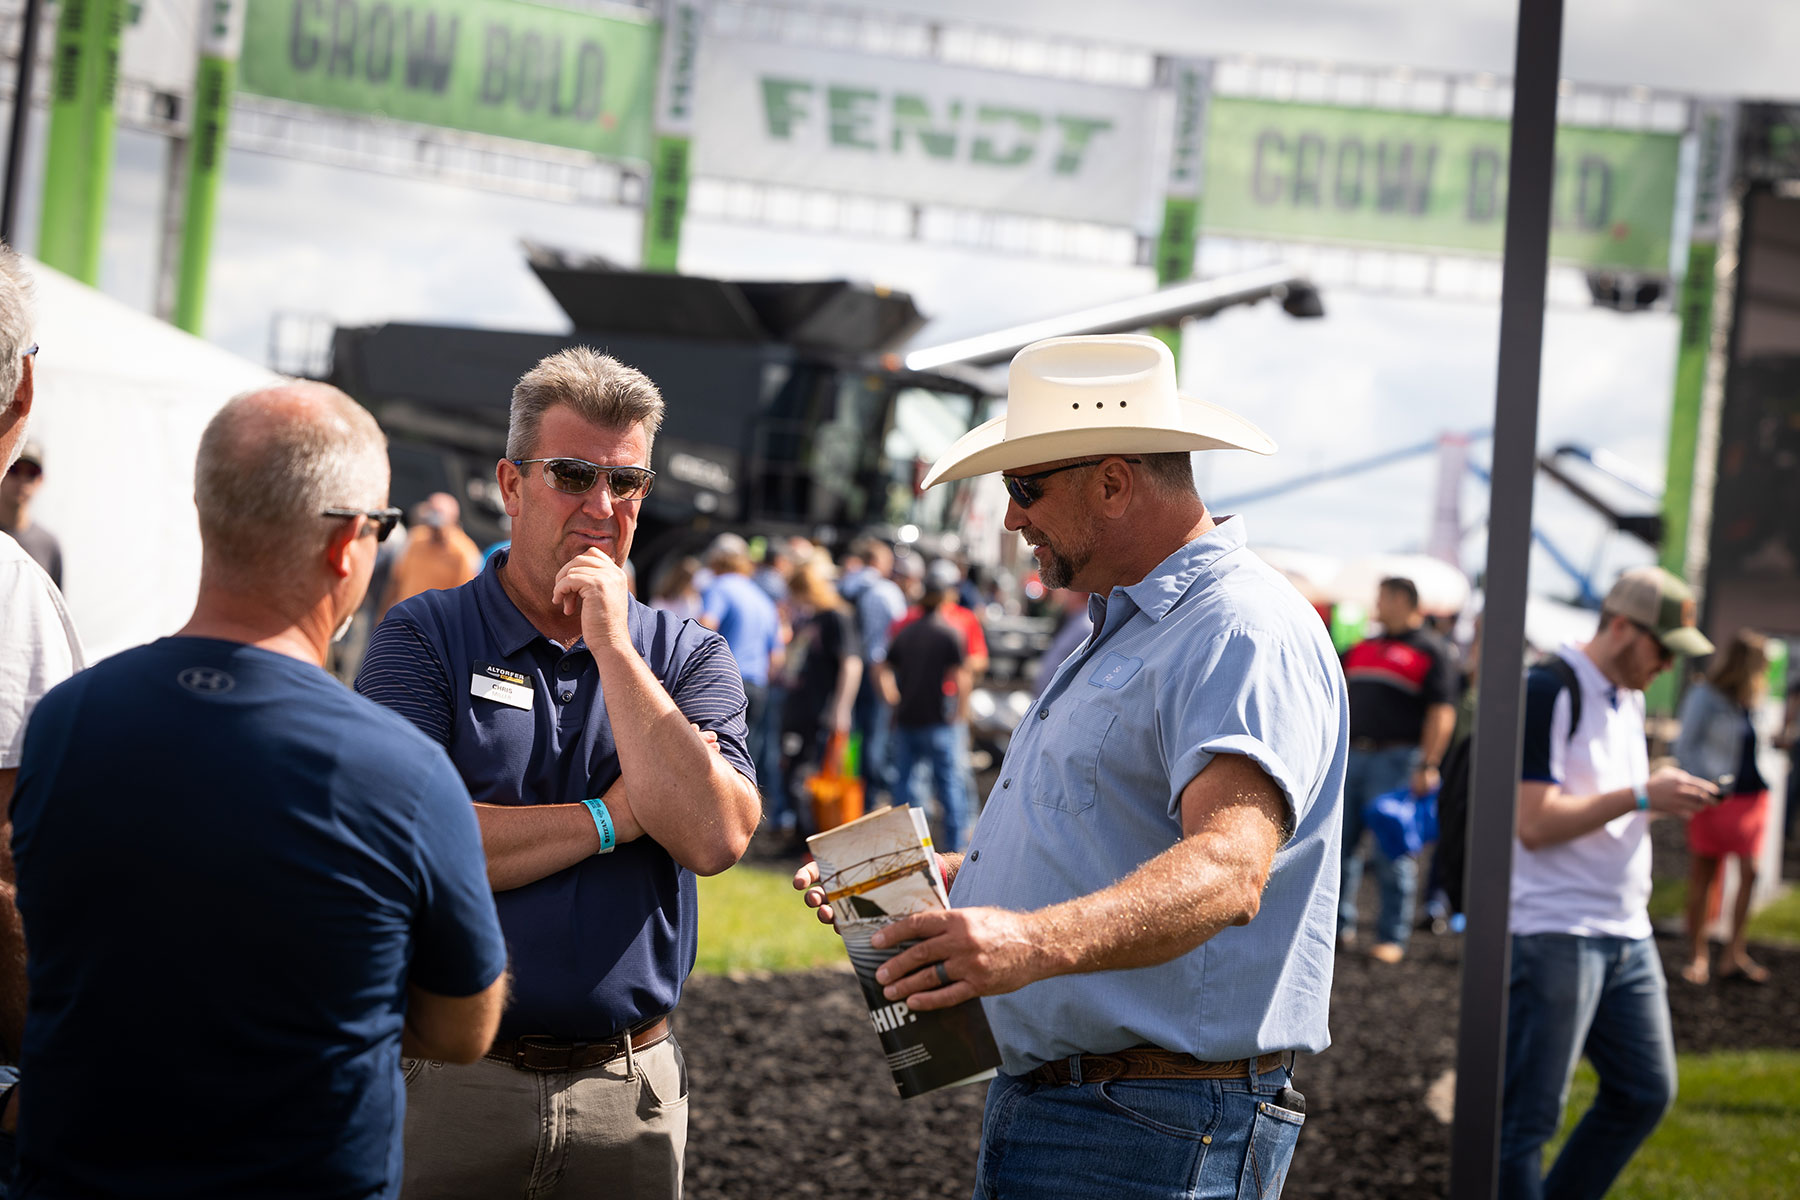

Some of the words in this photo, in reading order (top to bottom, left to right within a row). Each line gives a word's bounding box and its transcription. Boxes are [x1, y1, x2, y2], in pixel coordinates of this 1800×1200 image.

[289, 0, 459, 95] GROW
[760, 77, 1113, 175] FENDT
[1252, 128, 1438, 217] GROW
[487, 665, 525, 680] ALTORFER
[492, 683, 513, 694] CHRIS
[868, 1001, 917, 1034] HIP.
